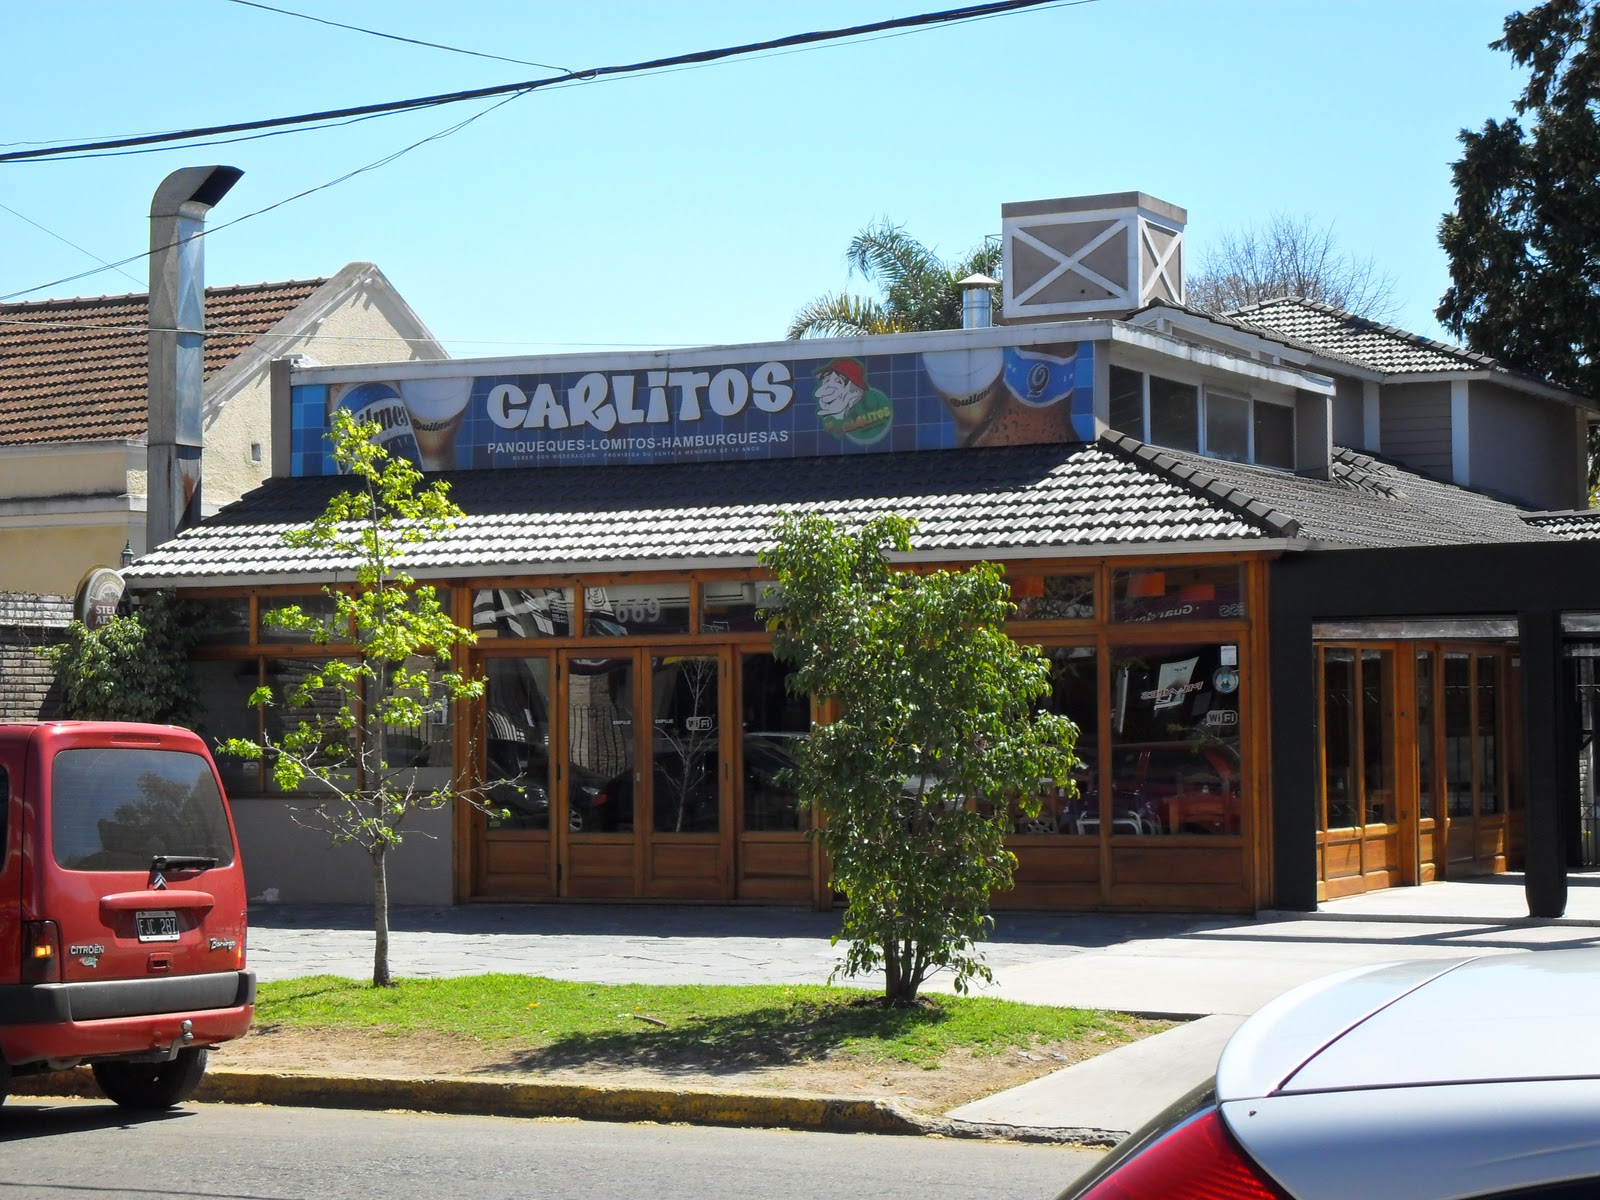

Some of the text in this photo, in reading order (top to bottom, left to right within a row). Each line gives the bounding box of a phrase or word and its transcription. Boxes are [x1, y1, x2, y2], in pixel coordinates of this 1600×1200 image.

[615, 597, 661, 623] 669
[138, 918, 157, 936] FJC
[70, 943, 105, 955] CITROËN
